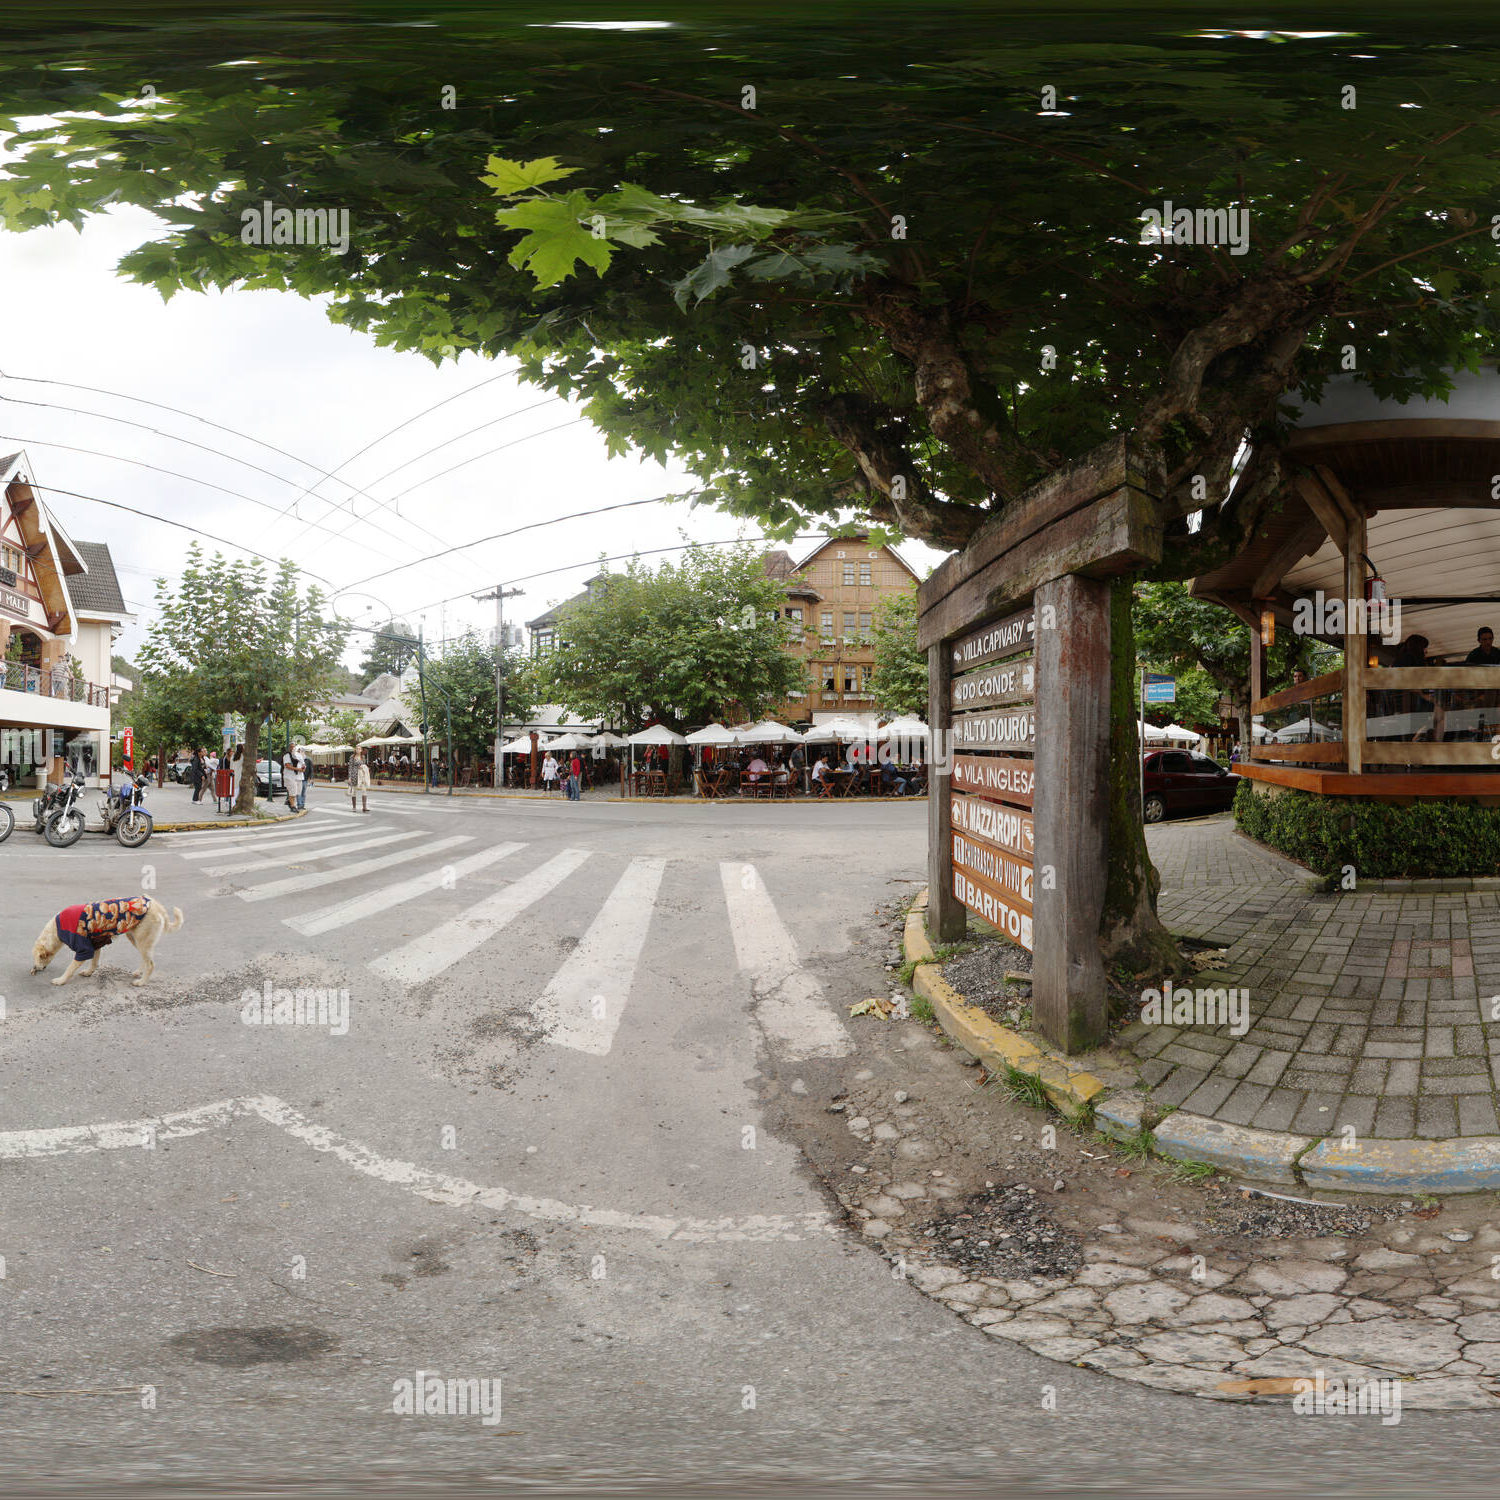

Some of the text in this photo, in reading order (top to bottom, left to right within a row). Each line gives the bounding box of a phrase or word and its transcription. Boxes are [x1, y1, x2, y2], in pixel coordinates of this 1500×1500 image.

[5, 592, 28, 612] MALL
[964, 619, 1024, 661] VILLA CAPIVARY
[962, 671, 1014, 700] DO CONDE
[964, 720, 987, 741] ALTO
[964, 765, 1034, 794] VILA INGLESA
[962, 800, 1020, 850] V. MAZZAROPI
[965, 842, 1020, 893] CHURRASCO AO VIVO
[967, 881, 1020, 937] BARITO
